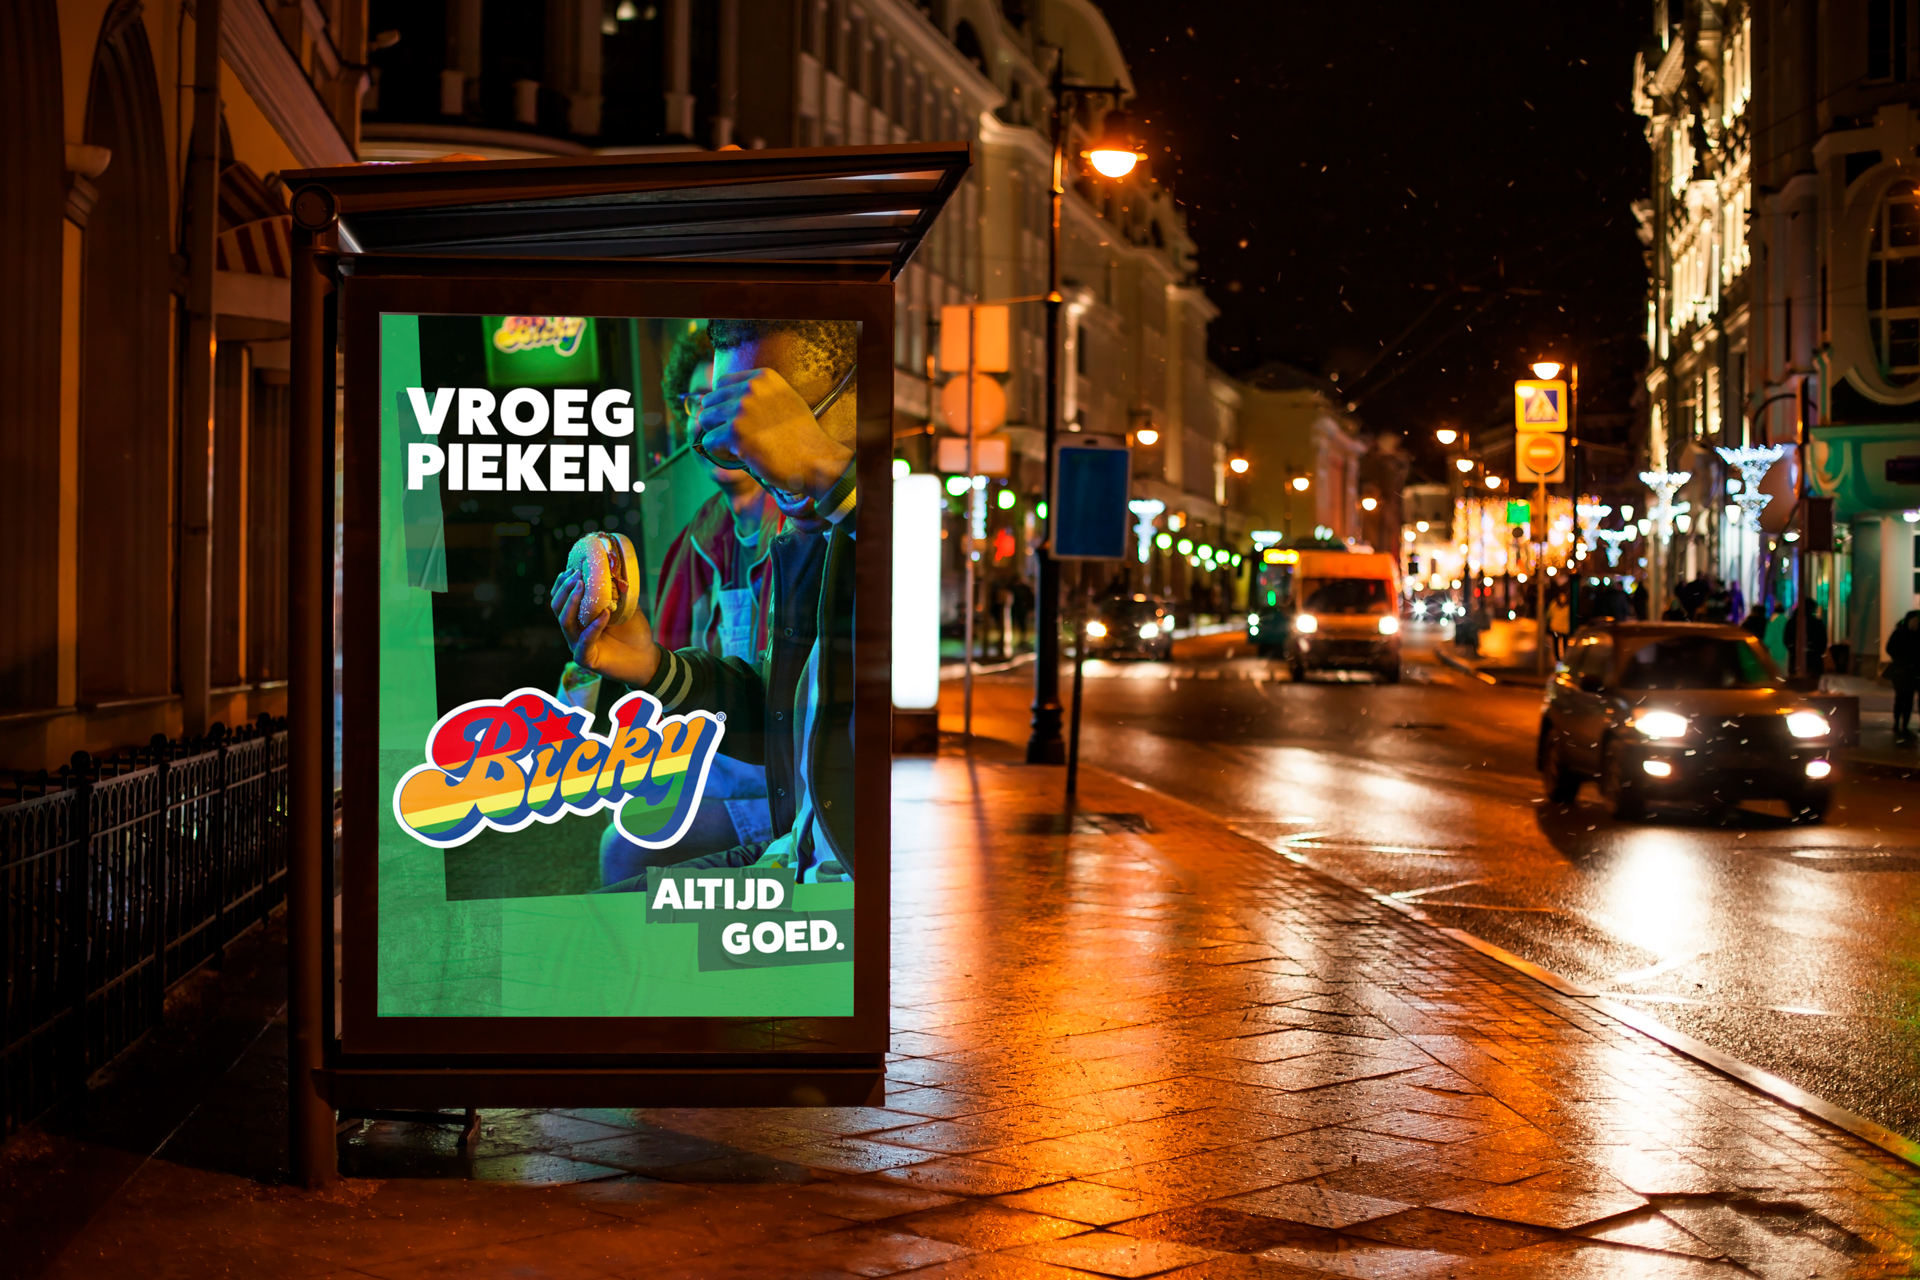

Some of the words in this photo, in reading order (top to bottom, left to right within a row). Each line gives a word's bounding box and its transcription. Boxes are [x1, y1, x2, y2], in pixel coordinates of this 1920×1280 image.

[406, 387, 635, 437] VROEG
[407, 443, 646, 493] PIEKEN.
[396, 690, 722, 846] Bicky
[652, 878, 785, 910] ALTIJD
[721, 919, 845, 955] GOED.
